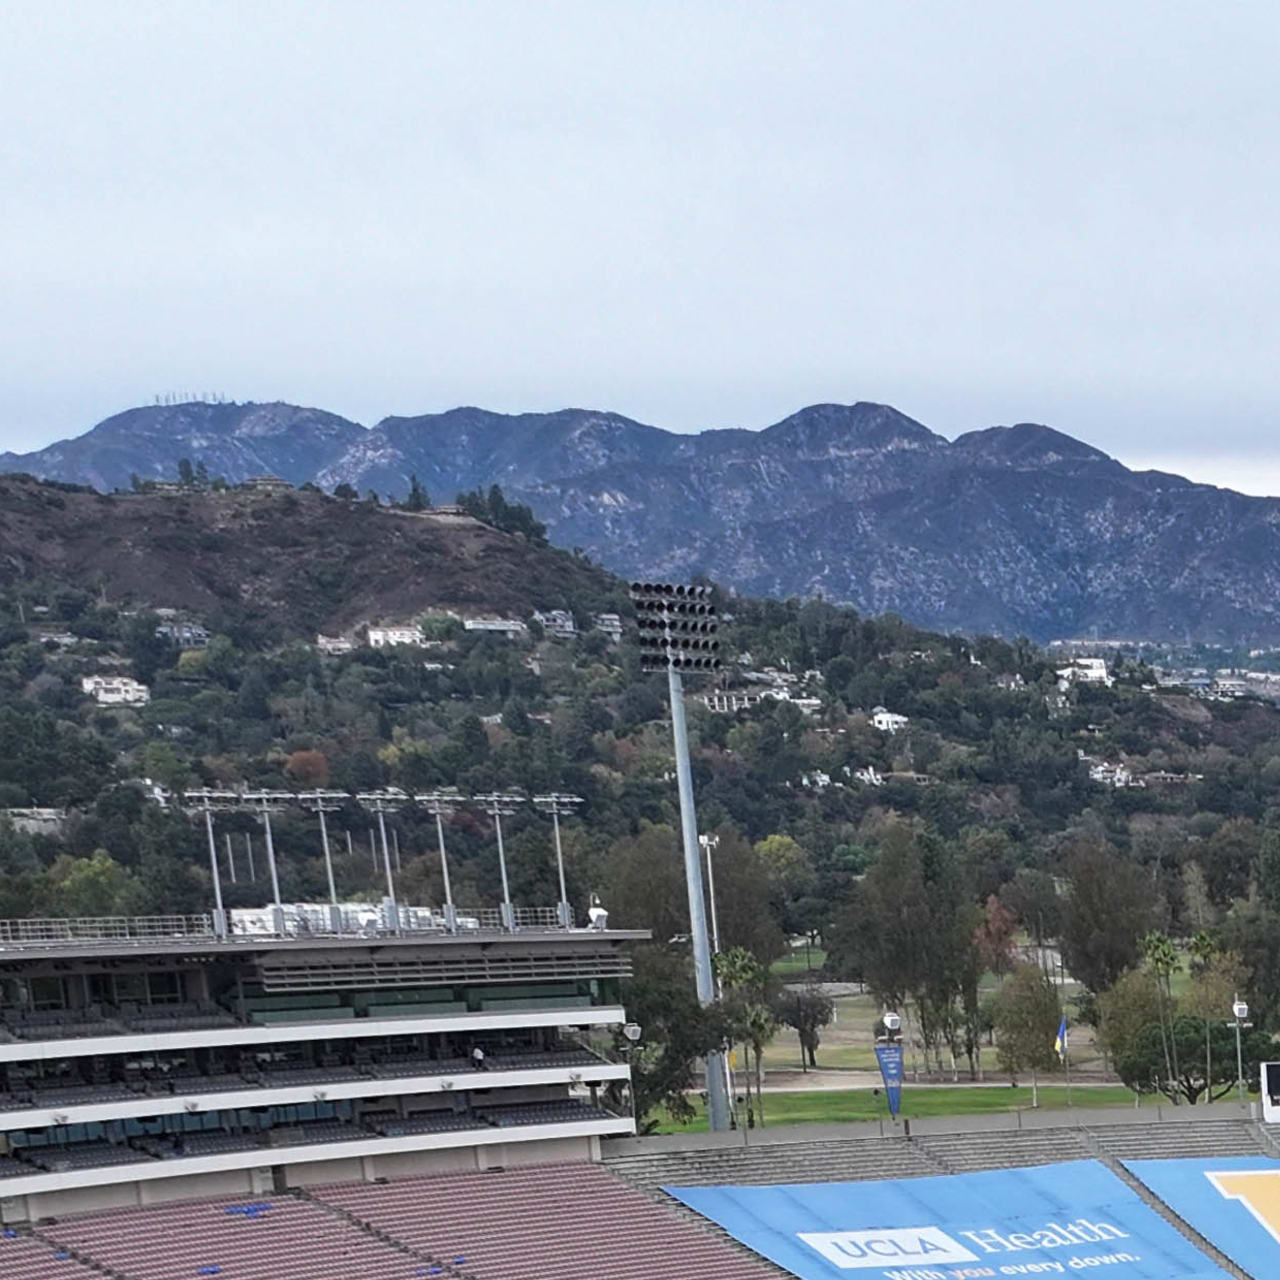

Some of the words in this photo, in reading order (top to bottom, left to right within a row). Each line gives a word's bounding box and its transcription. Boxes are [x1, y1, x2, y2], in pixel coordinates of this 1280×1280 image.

[829, 1238, 952, 1261] UCLA
[960, 1218, 1130, 1254] Health
[1000, 1262, 1065, 1278] every
[1067, 1254, 1141, 1272] down.
